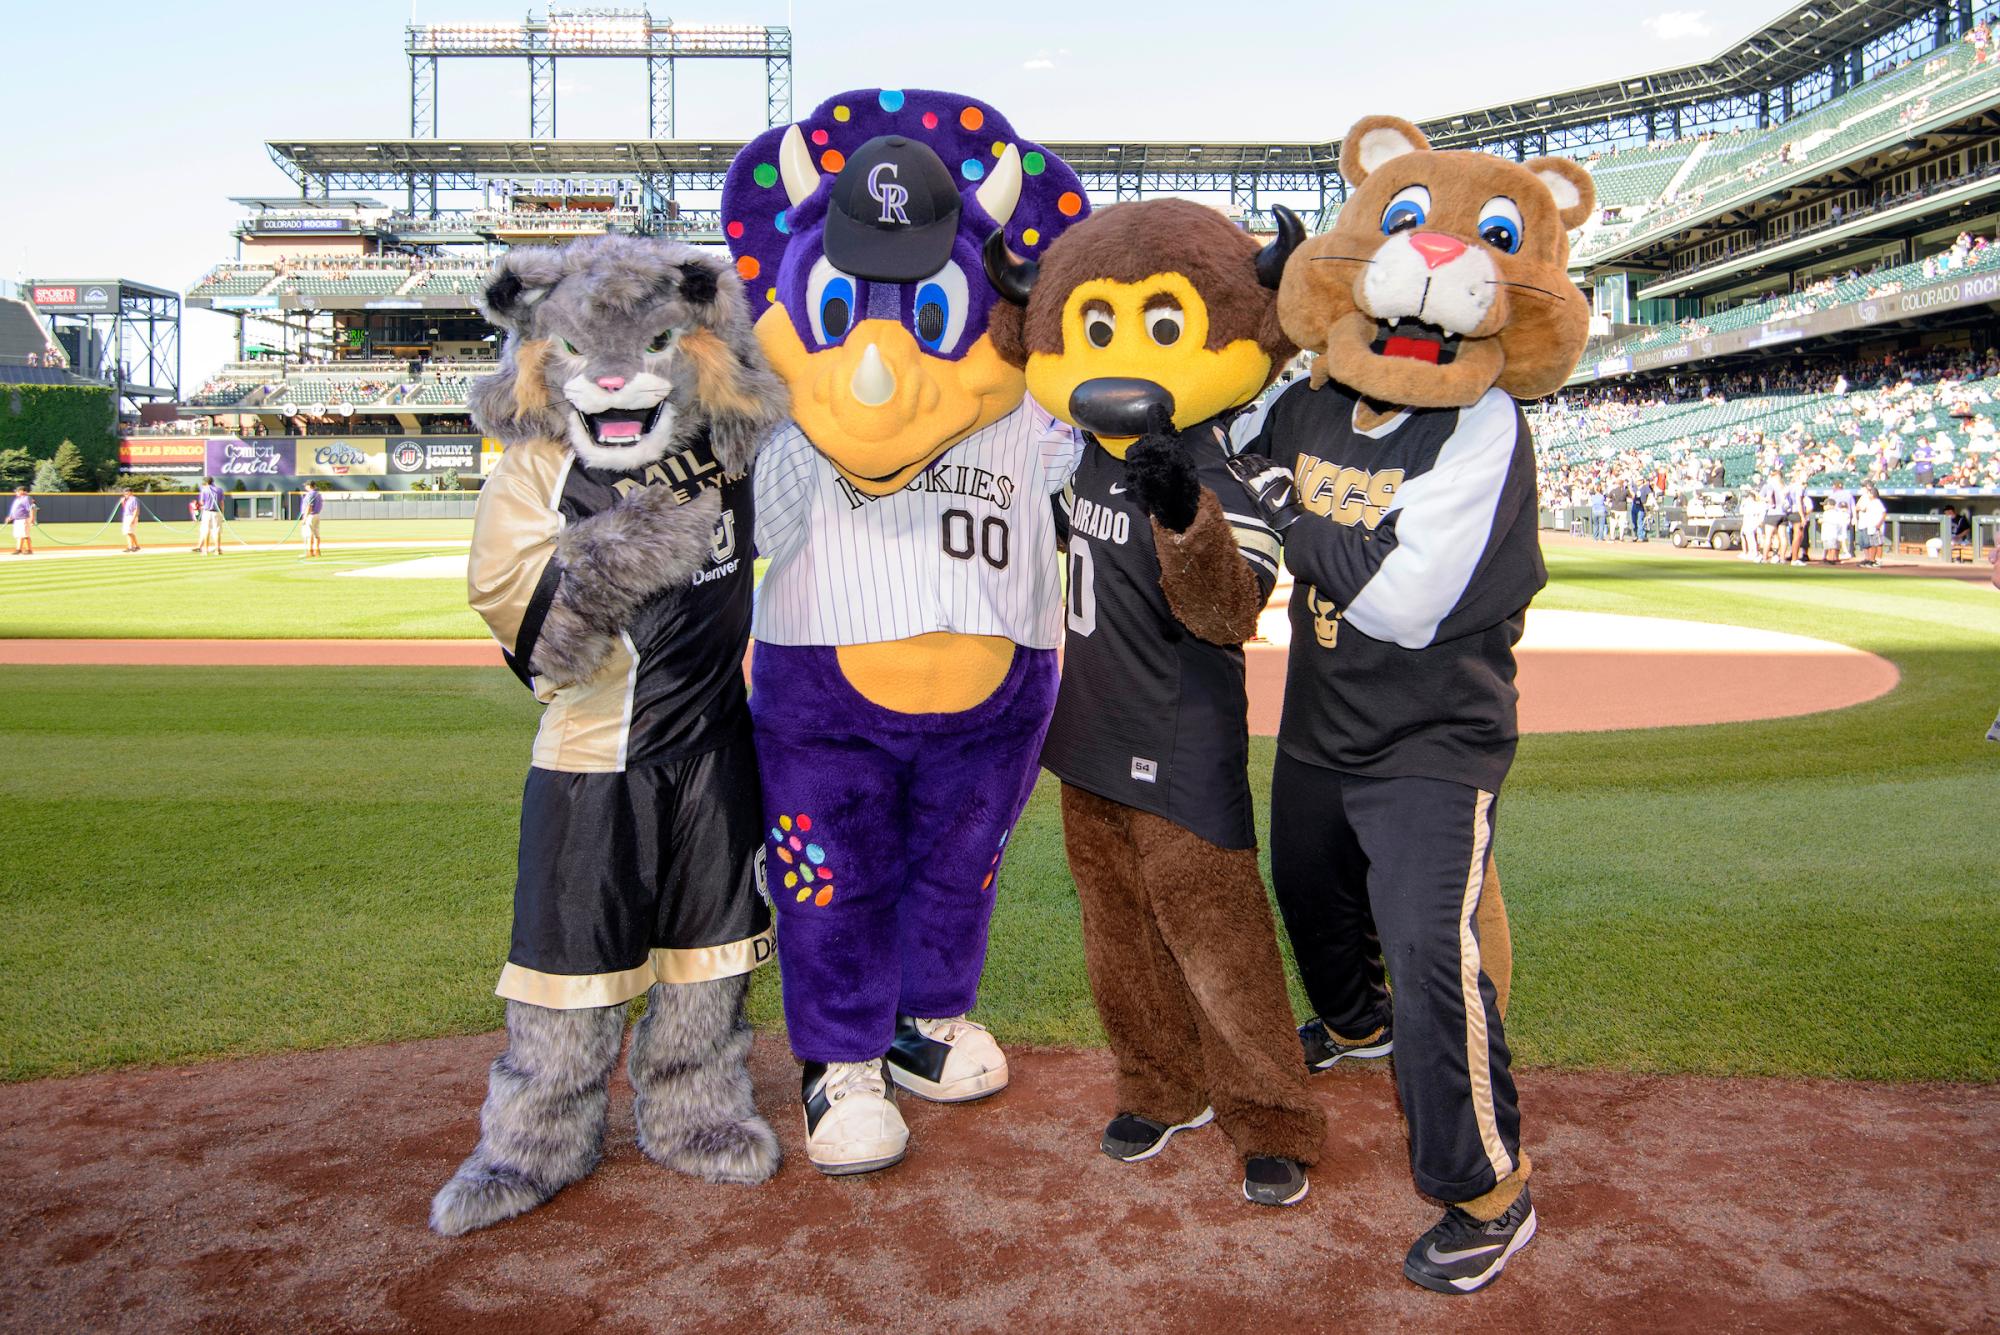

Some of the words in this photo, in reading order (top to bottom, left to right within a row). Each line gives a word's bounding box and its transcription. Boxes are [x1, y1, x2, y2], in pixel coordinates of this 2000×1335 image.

[867, 162, 911, 225] CR
[263, 220, 302, 229] COLORADO
[303, 220, 338, 229] ROCKIES
[36, 288, 76, 298] SPORTS
[1901, 284, 1960, 313] COLORADO
[1635, 351, 1663, 367] COLORADO
[1663, 345, 1688, 361] ROCKIES
[163, 446, 204, 456] FARGO
[315, 446, 366, 465] Coors
[426, 445, 474, 456] JIMMY
[612, 450, 717, 499] MIL
[941, 508, 1010, 571] 00
[692, 558, 741, 586] Denver
[1135, 762, 1150, 772] 54
